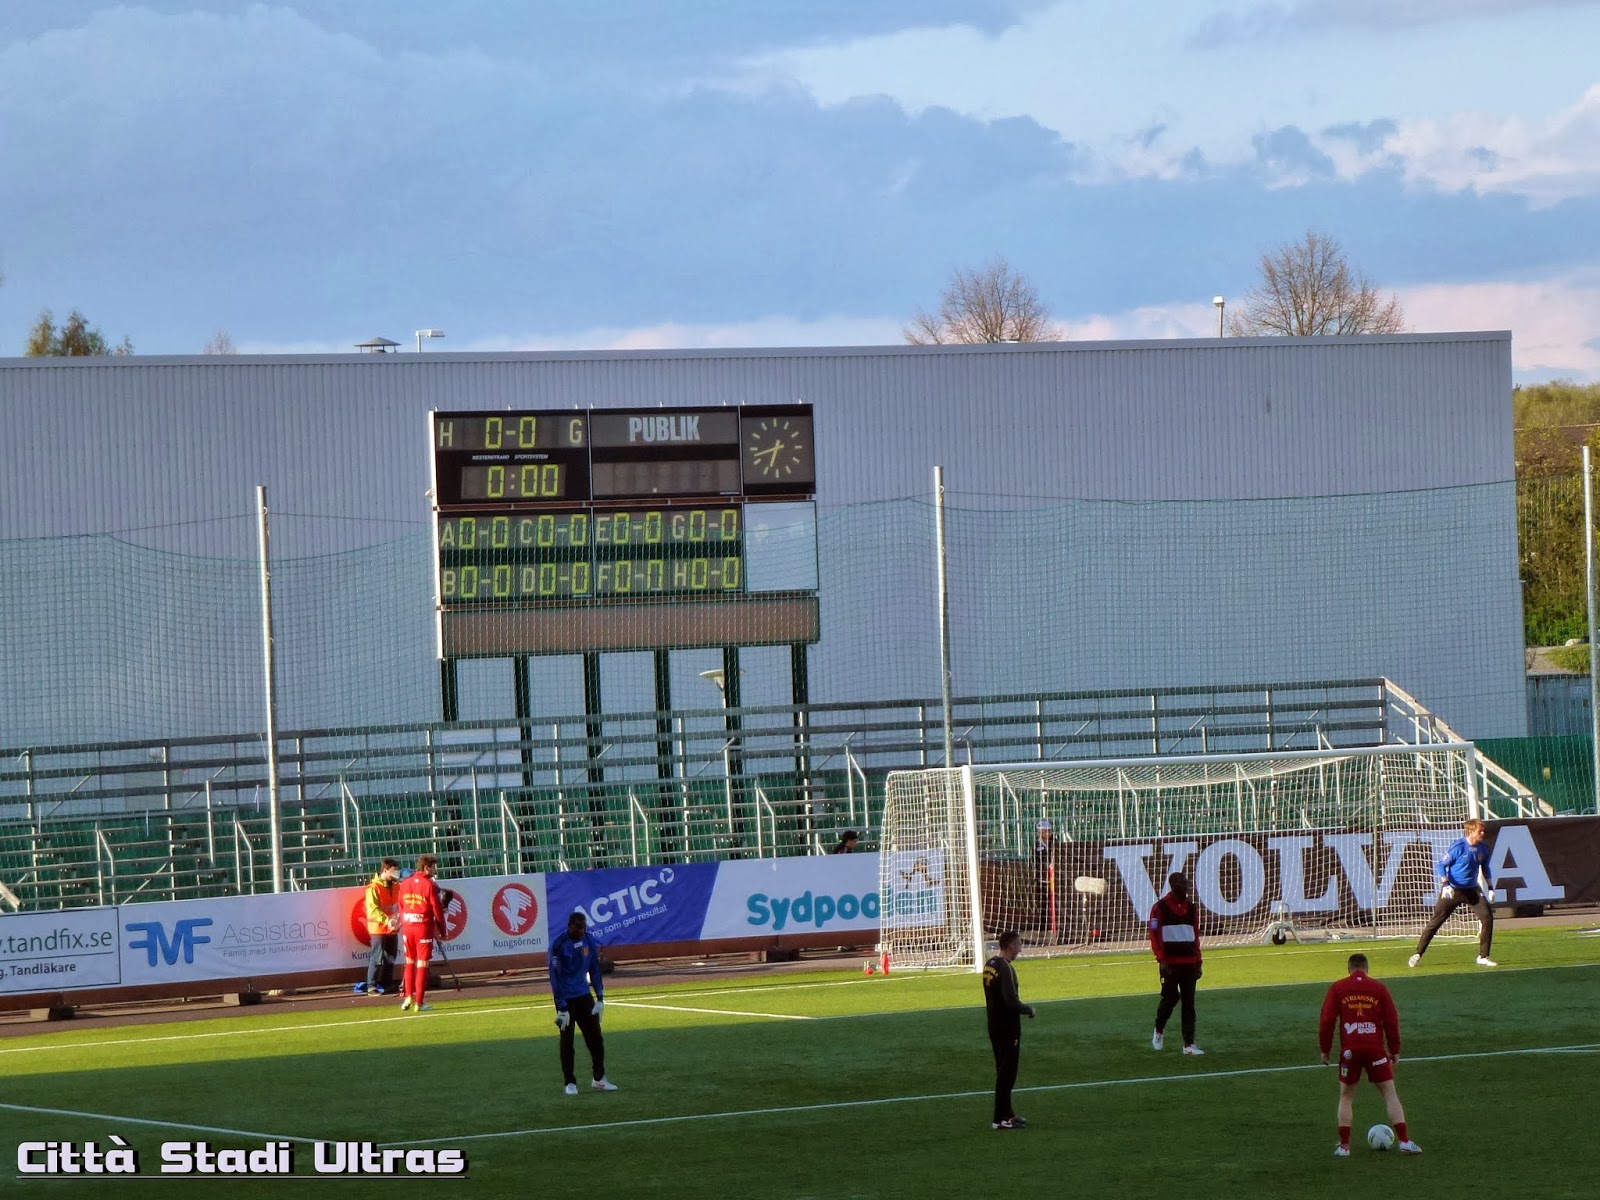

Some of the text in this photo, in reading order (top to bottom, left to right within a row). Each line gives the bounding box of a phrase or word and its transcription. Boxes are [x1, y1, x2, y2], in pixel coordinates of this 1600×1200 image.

[439, 416, 583, 449] H 0-0 G
[628, 415, 700, 443] PUBLIK
[487, 464, 559, 498] 0:00
[574, 879, 662, 927] ACTIC
[221, 920, 330, 944] Assistans
[604, 904, 668, 933] som ger resultat
[492, 937, 541, 949] Kungsörnen
[10, 962, 76, 976] Tandläkare
